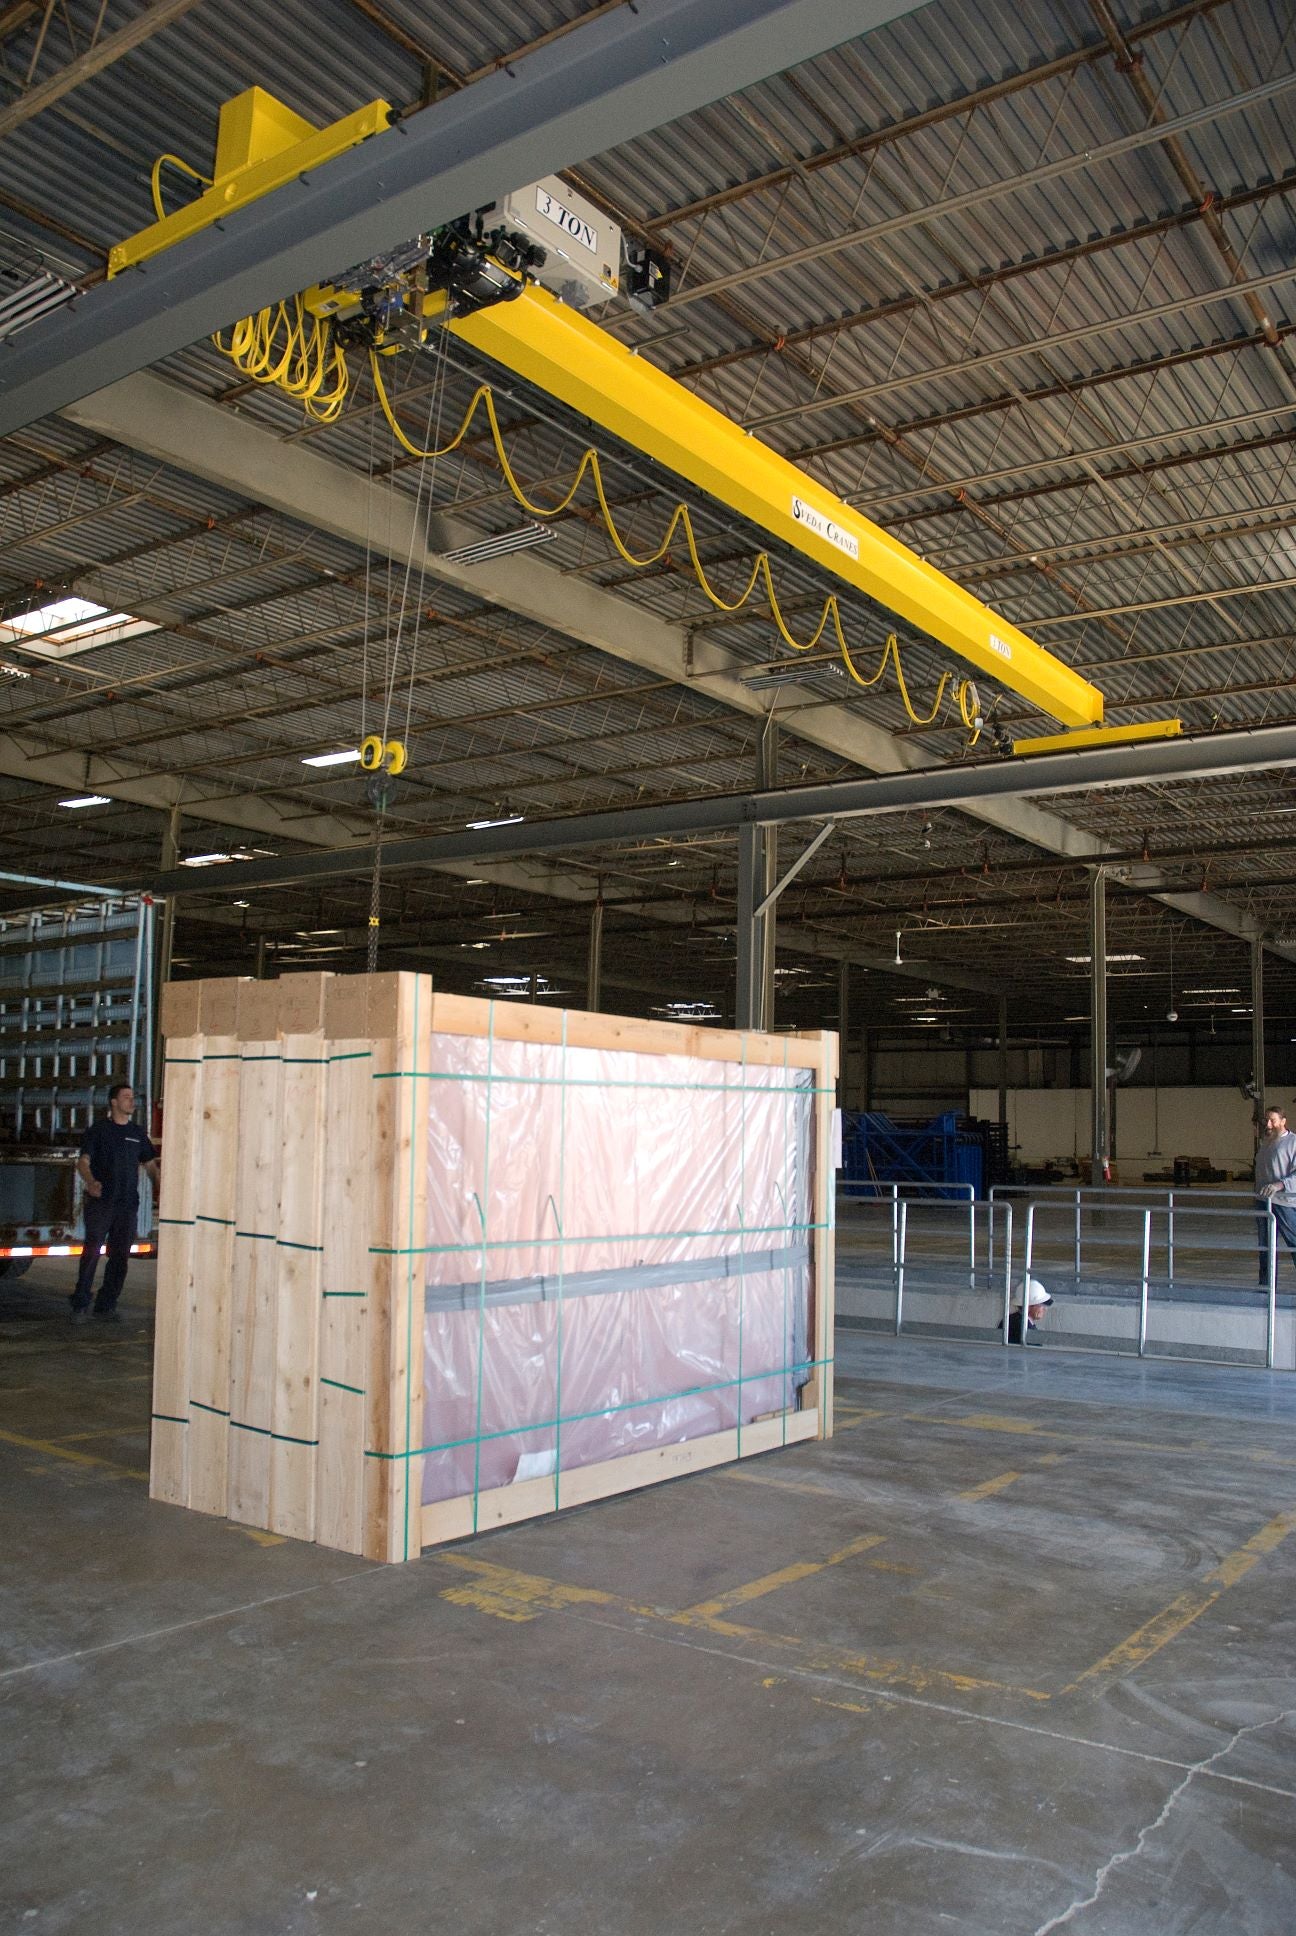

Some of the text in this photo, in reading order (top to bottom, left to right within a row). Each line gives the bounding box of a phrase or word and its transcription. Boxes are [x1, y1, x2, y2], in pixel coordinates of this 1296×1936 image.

[543, 196, 595, 245] 3 TON
[827, 522, 858, 556] CRANES
